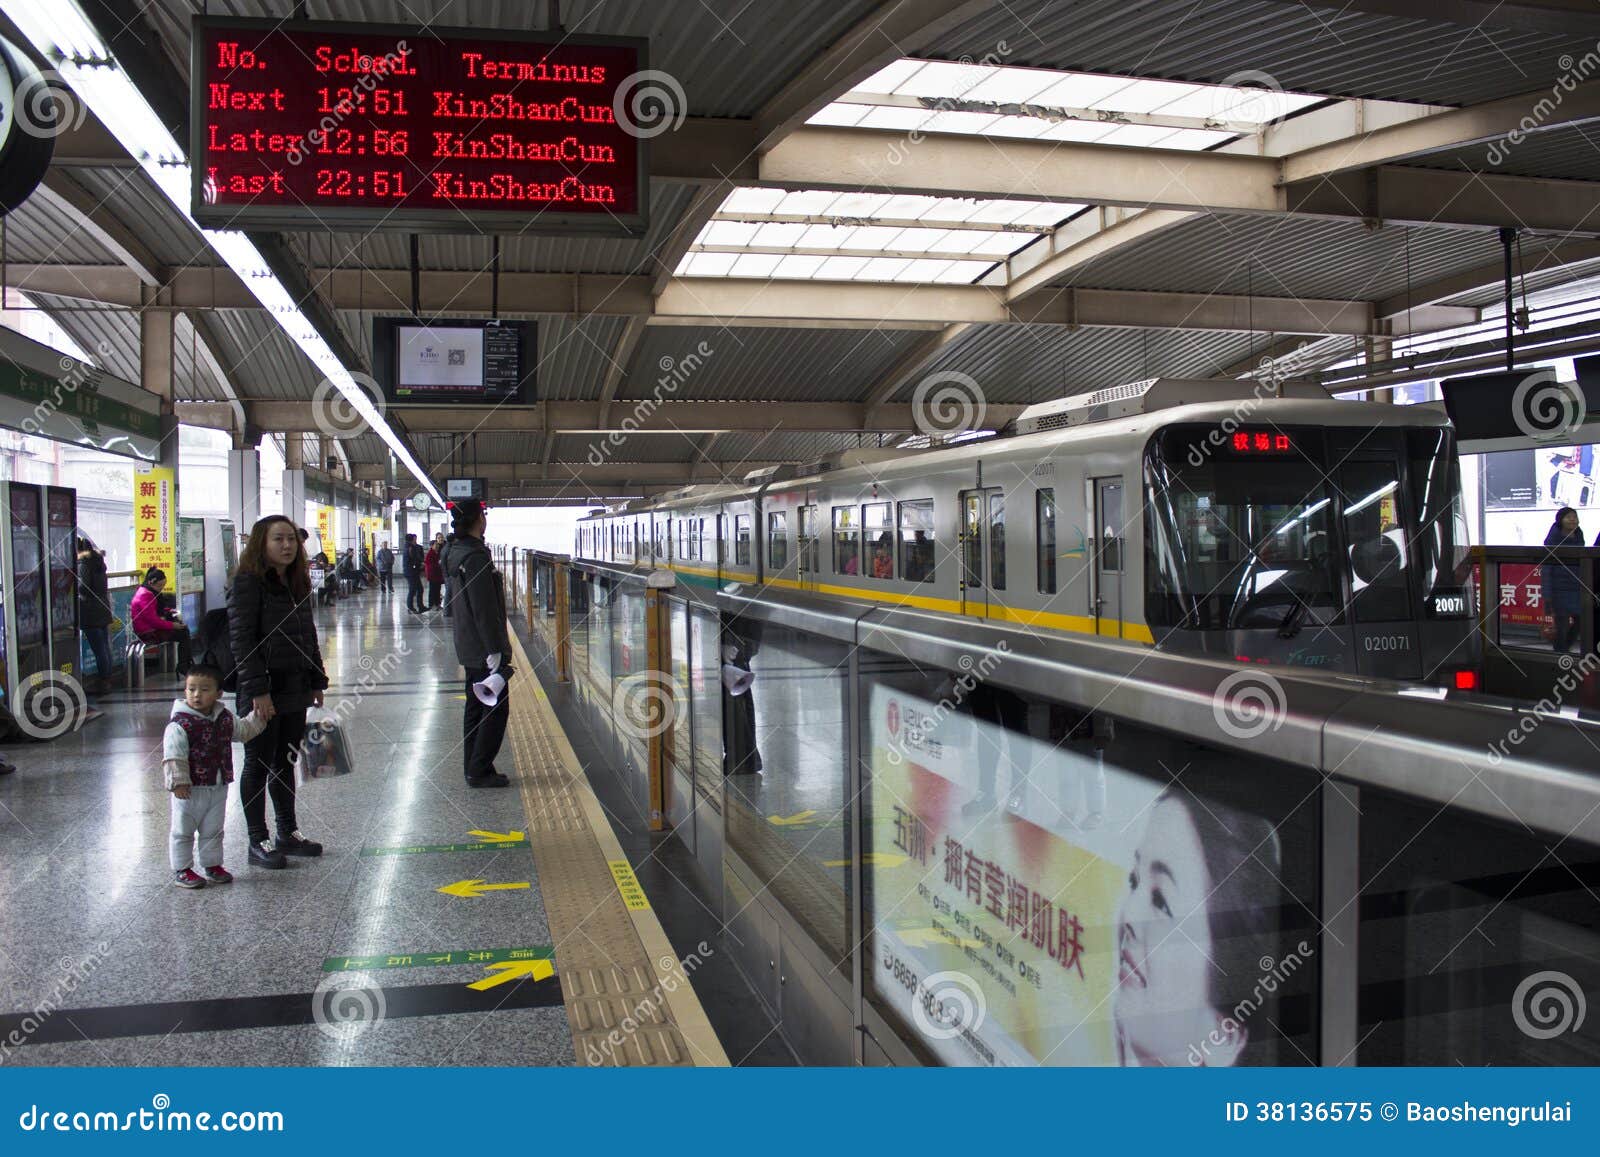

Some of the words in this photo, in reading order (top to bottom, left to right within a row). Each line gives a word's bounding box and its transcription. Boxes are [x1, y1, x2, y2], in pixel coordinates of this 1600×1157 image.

[217, 42, 267, 69] No.
[315, 46, 417, 75] Sched.
[462, 53, 606, 84] Terminus
[209, 83, 285, 111] Next
[317, 87, 408, 115] 12:51
[432, 91, 615, 123] XinShanCun
[208, 124, 303, 153] Later
[317, 128, 409, 155] 12:56
[432, 131, 615, 162] XinShanCun
[207, 167, 285, 195] Last
[316, 169, 408, 198] 22:51
[432, 172, 616, 203] XinShanCun
[139, 481, 157, 543] 新东方
[1364, 636, 1409, 651] 020071
